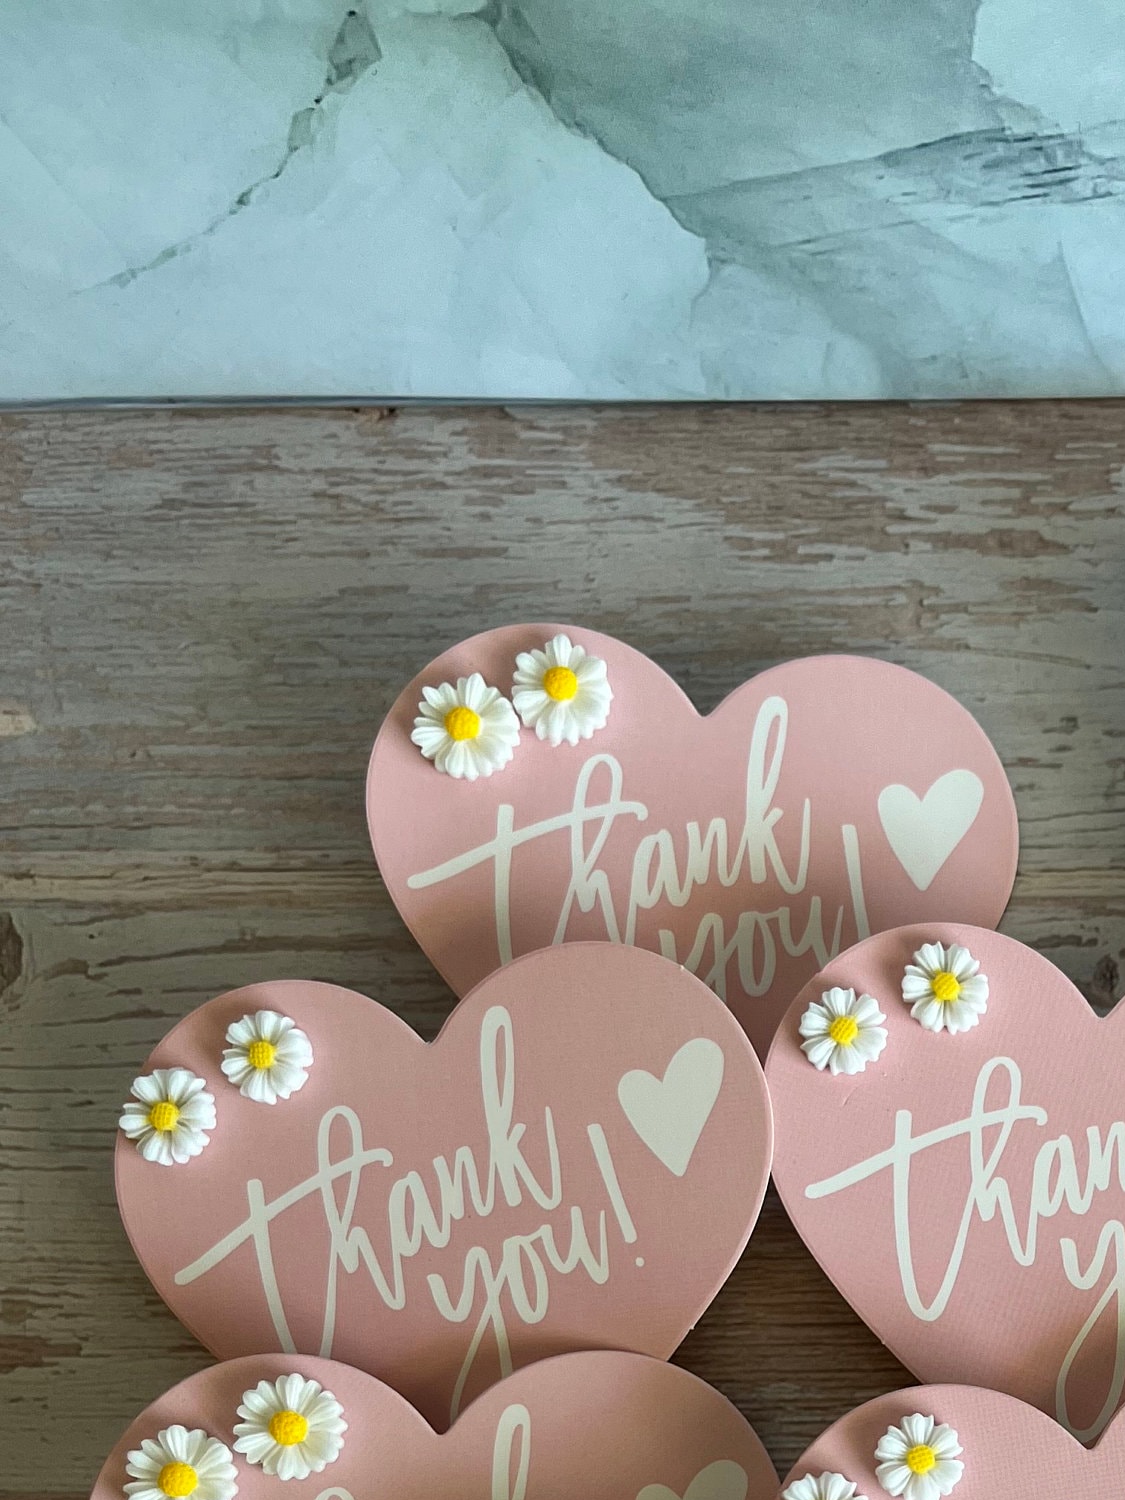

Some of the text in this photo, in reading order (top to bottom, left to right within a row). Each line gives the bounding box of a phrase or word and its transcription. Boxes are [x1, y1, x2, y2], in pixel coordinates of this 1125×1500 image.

[408, 696, 811, 962] thank
[175, 1006, 563, 1359] thank
[428, 1123, 646, 1417] you!
